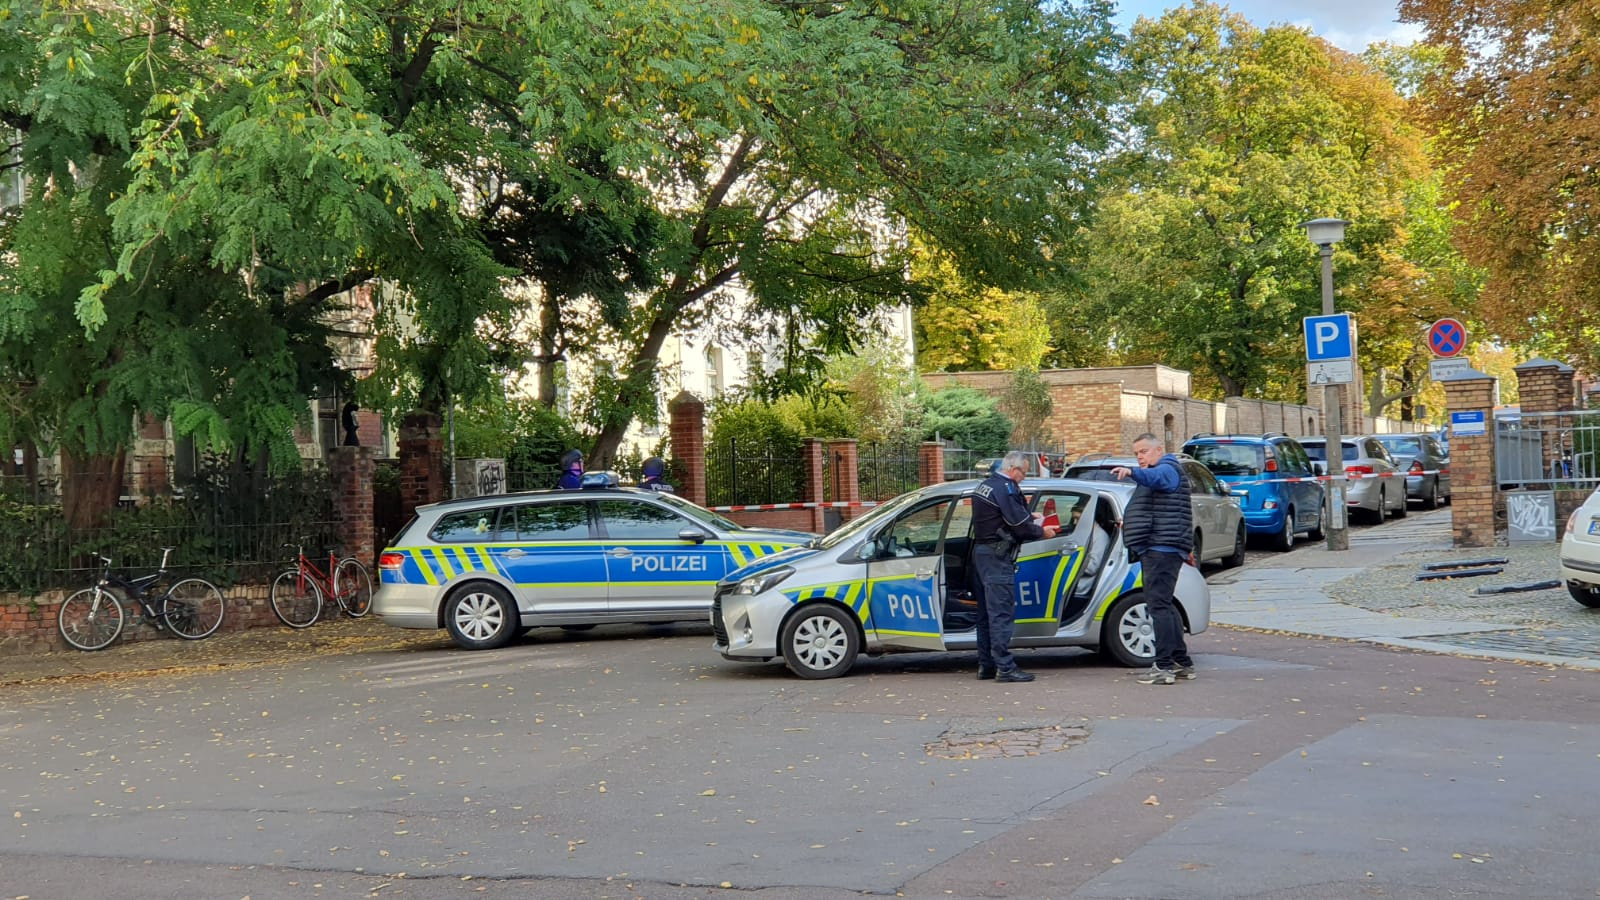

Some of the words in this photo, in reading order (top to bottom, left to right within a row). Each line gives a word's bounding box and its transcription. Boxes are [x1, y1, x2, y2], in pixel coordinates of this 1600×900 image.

[1314, 321, 1340, 355] P
[631, 555, 707, 572] POLIZEI
[887, 593, 936, 620] POLI
[1014, 581, 1041, 606] EI
